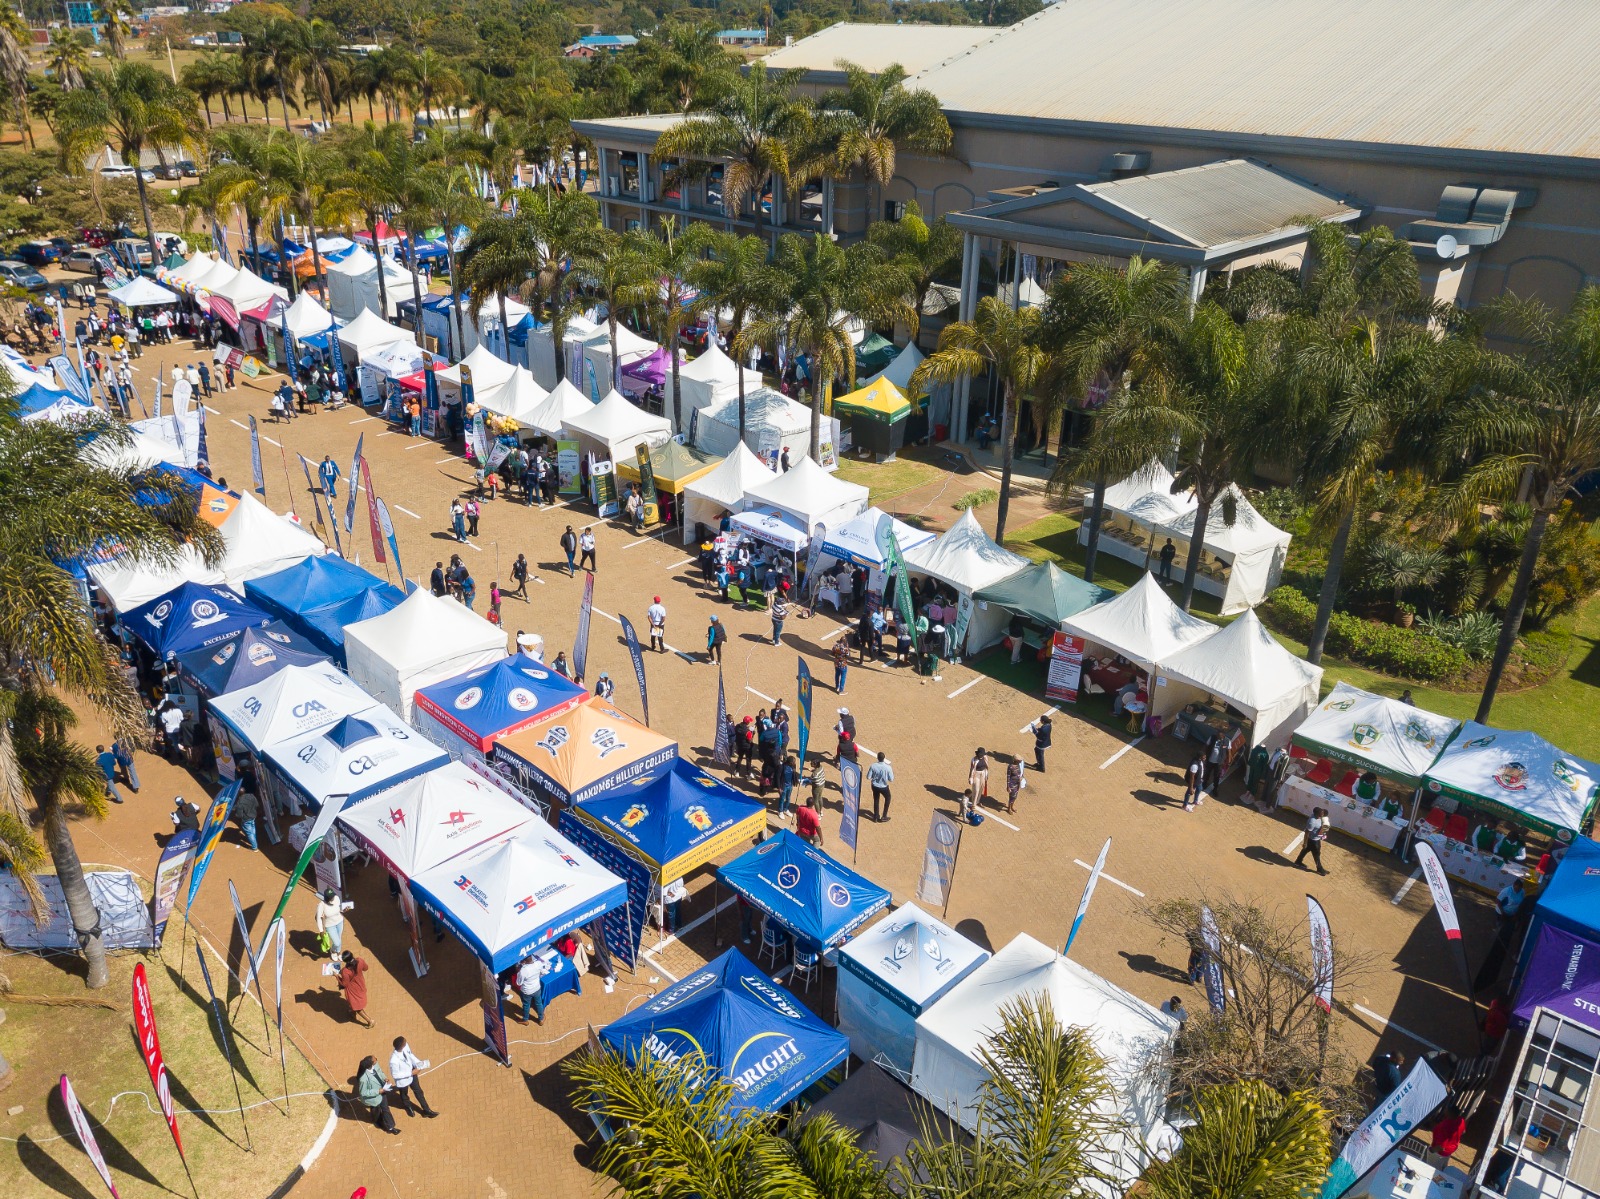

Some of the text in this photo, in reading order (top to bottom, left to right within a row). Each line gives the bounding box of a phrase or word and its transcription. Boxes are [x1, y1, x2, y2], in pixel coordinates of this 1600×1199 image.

[203, 630, 241, 646] EXCELLENCE
[244, 696, 262, 718] CAA
[292, 699, 327, 718] CAA
[576, 776, 615, 804] MAKUMBE
[615, 761, 645, 788] HILLTOP
[643, 748, 675, 773] COLLEGE
[543, 778, 568, 804] COLLEGE
[1480, 798, 1514, 815] JUNIOR
[625, 830, 640, 844] College
[705, 825, 718, 838] Heart
[717, 818, 734, 831] College
[363, 841, 380, 862] Agility
[467, 887, 489, 908] ENGINEERING
[537, 883, 567, 901] ENGINEERING
[724, 875, 750, 899] Innovate
[749, 892, 775, 916] Institute
[774, 908, 790, 926] High
[789, 920, 811, 941] School
[518, 938, 539, 957] ALL
[551, 919, 574, 936] AUTO
[574, 902, 607, 925] REPAIRS
[1567, 944, 1583, 973] STEWARD
[742, 976, 801, 1020] BRIGHT
[890, 991, 908, 1007] SCHOOL
[732, 1037, 799, 1092] BRIGHT
[742, 1070, 780, 1101] INSURANCE
[778, 1052, 806, 1075] BROKERS
